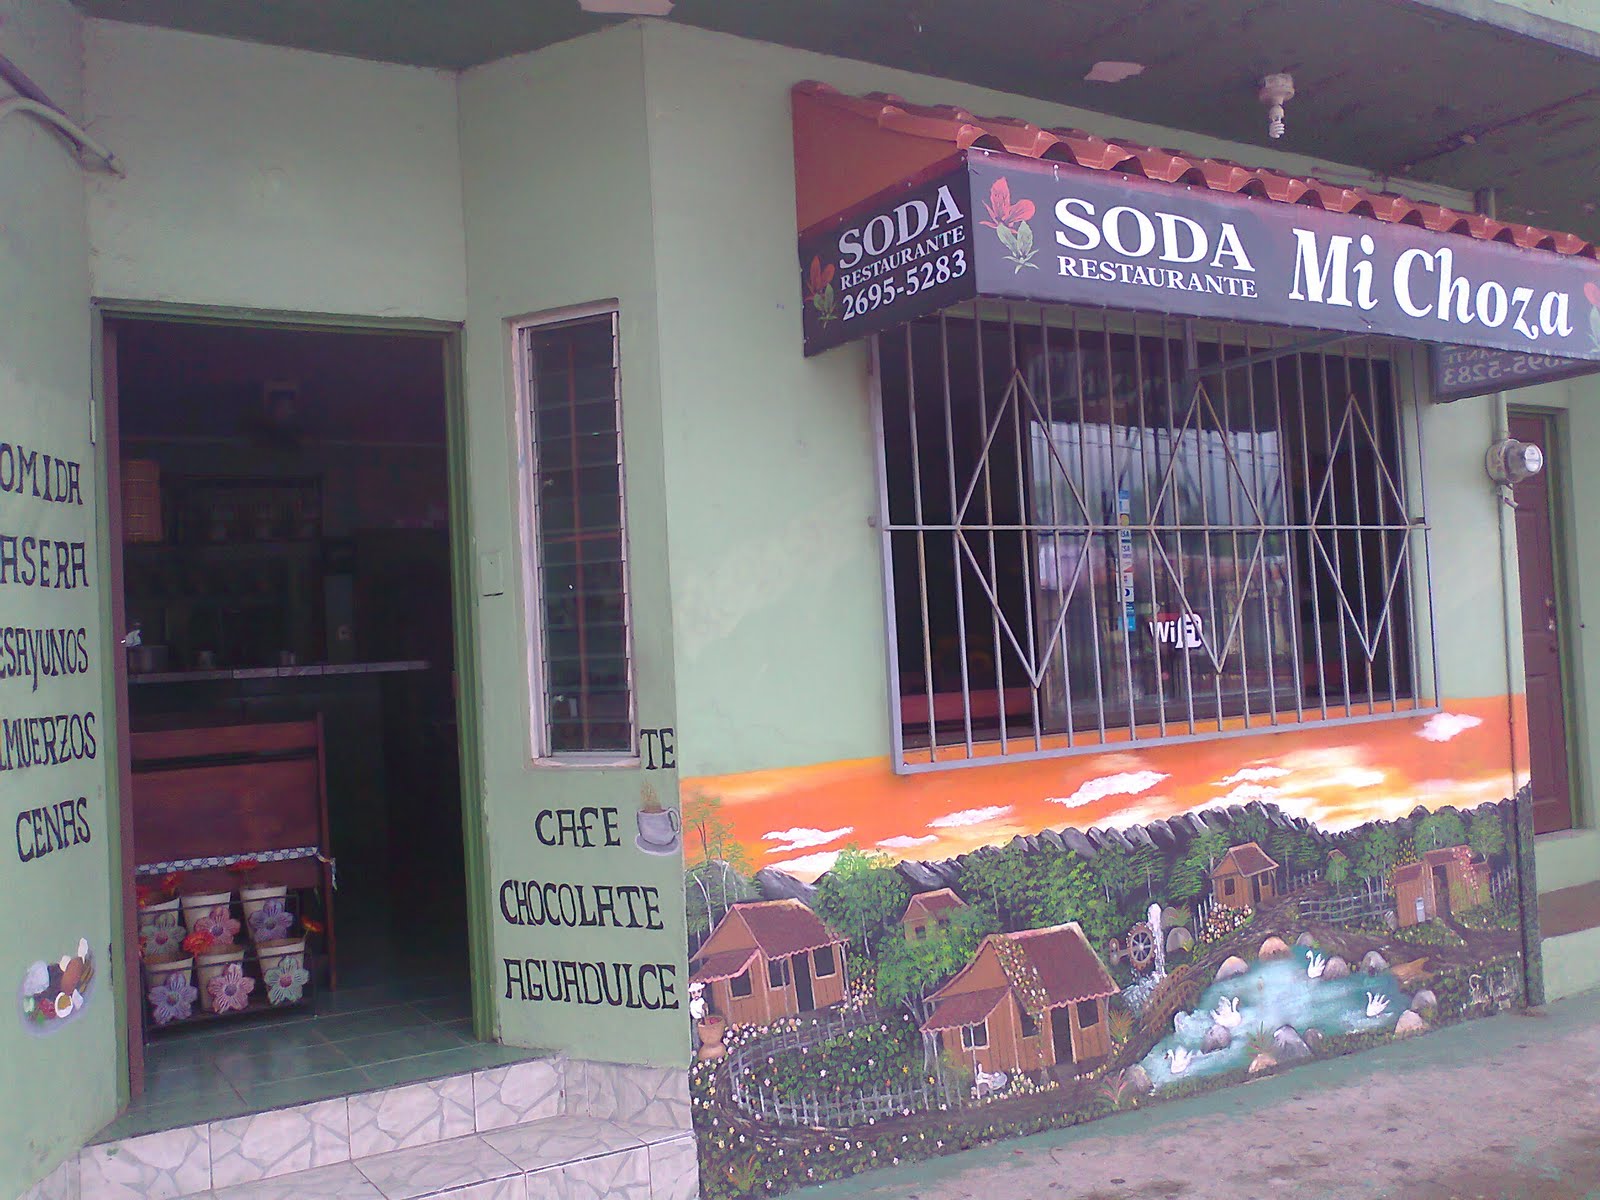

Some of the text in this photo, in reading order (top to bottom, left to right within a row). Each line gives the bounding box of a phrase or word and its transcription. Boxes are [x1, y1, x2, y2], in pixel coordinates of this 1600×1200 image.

[838, 184, 964, 269] SODA
[840, 225, 966, 291] RESTAURANTE
[1054, 197, 1256, 272] SODA
[841, 248, 967, 321] 2695-5283
[1056, 255, 1259, 298] RESTAURANTE
[1288, 228, 1574, 340] Mi Choza
[640, 727, 676, 770] TE
[16, 796, 91, 863] CENAS
[534, 806, 621, 847] CAFE
[499, 879, 664, 930] CHOCOLATE
[503, 958, 680, 1010] AGUADULCE
